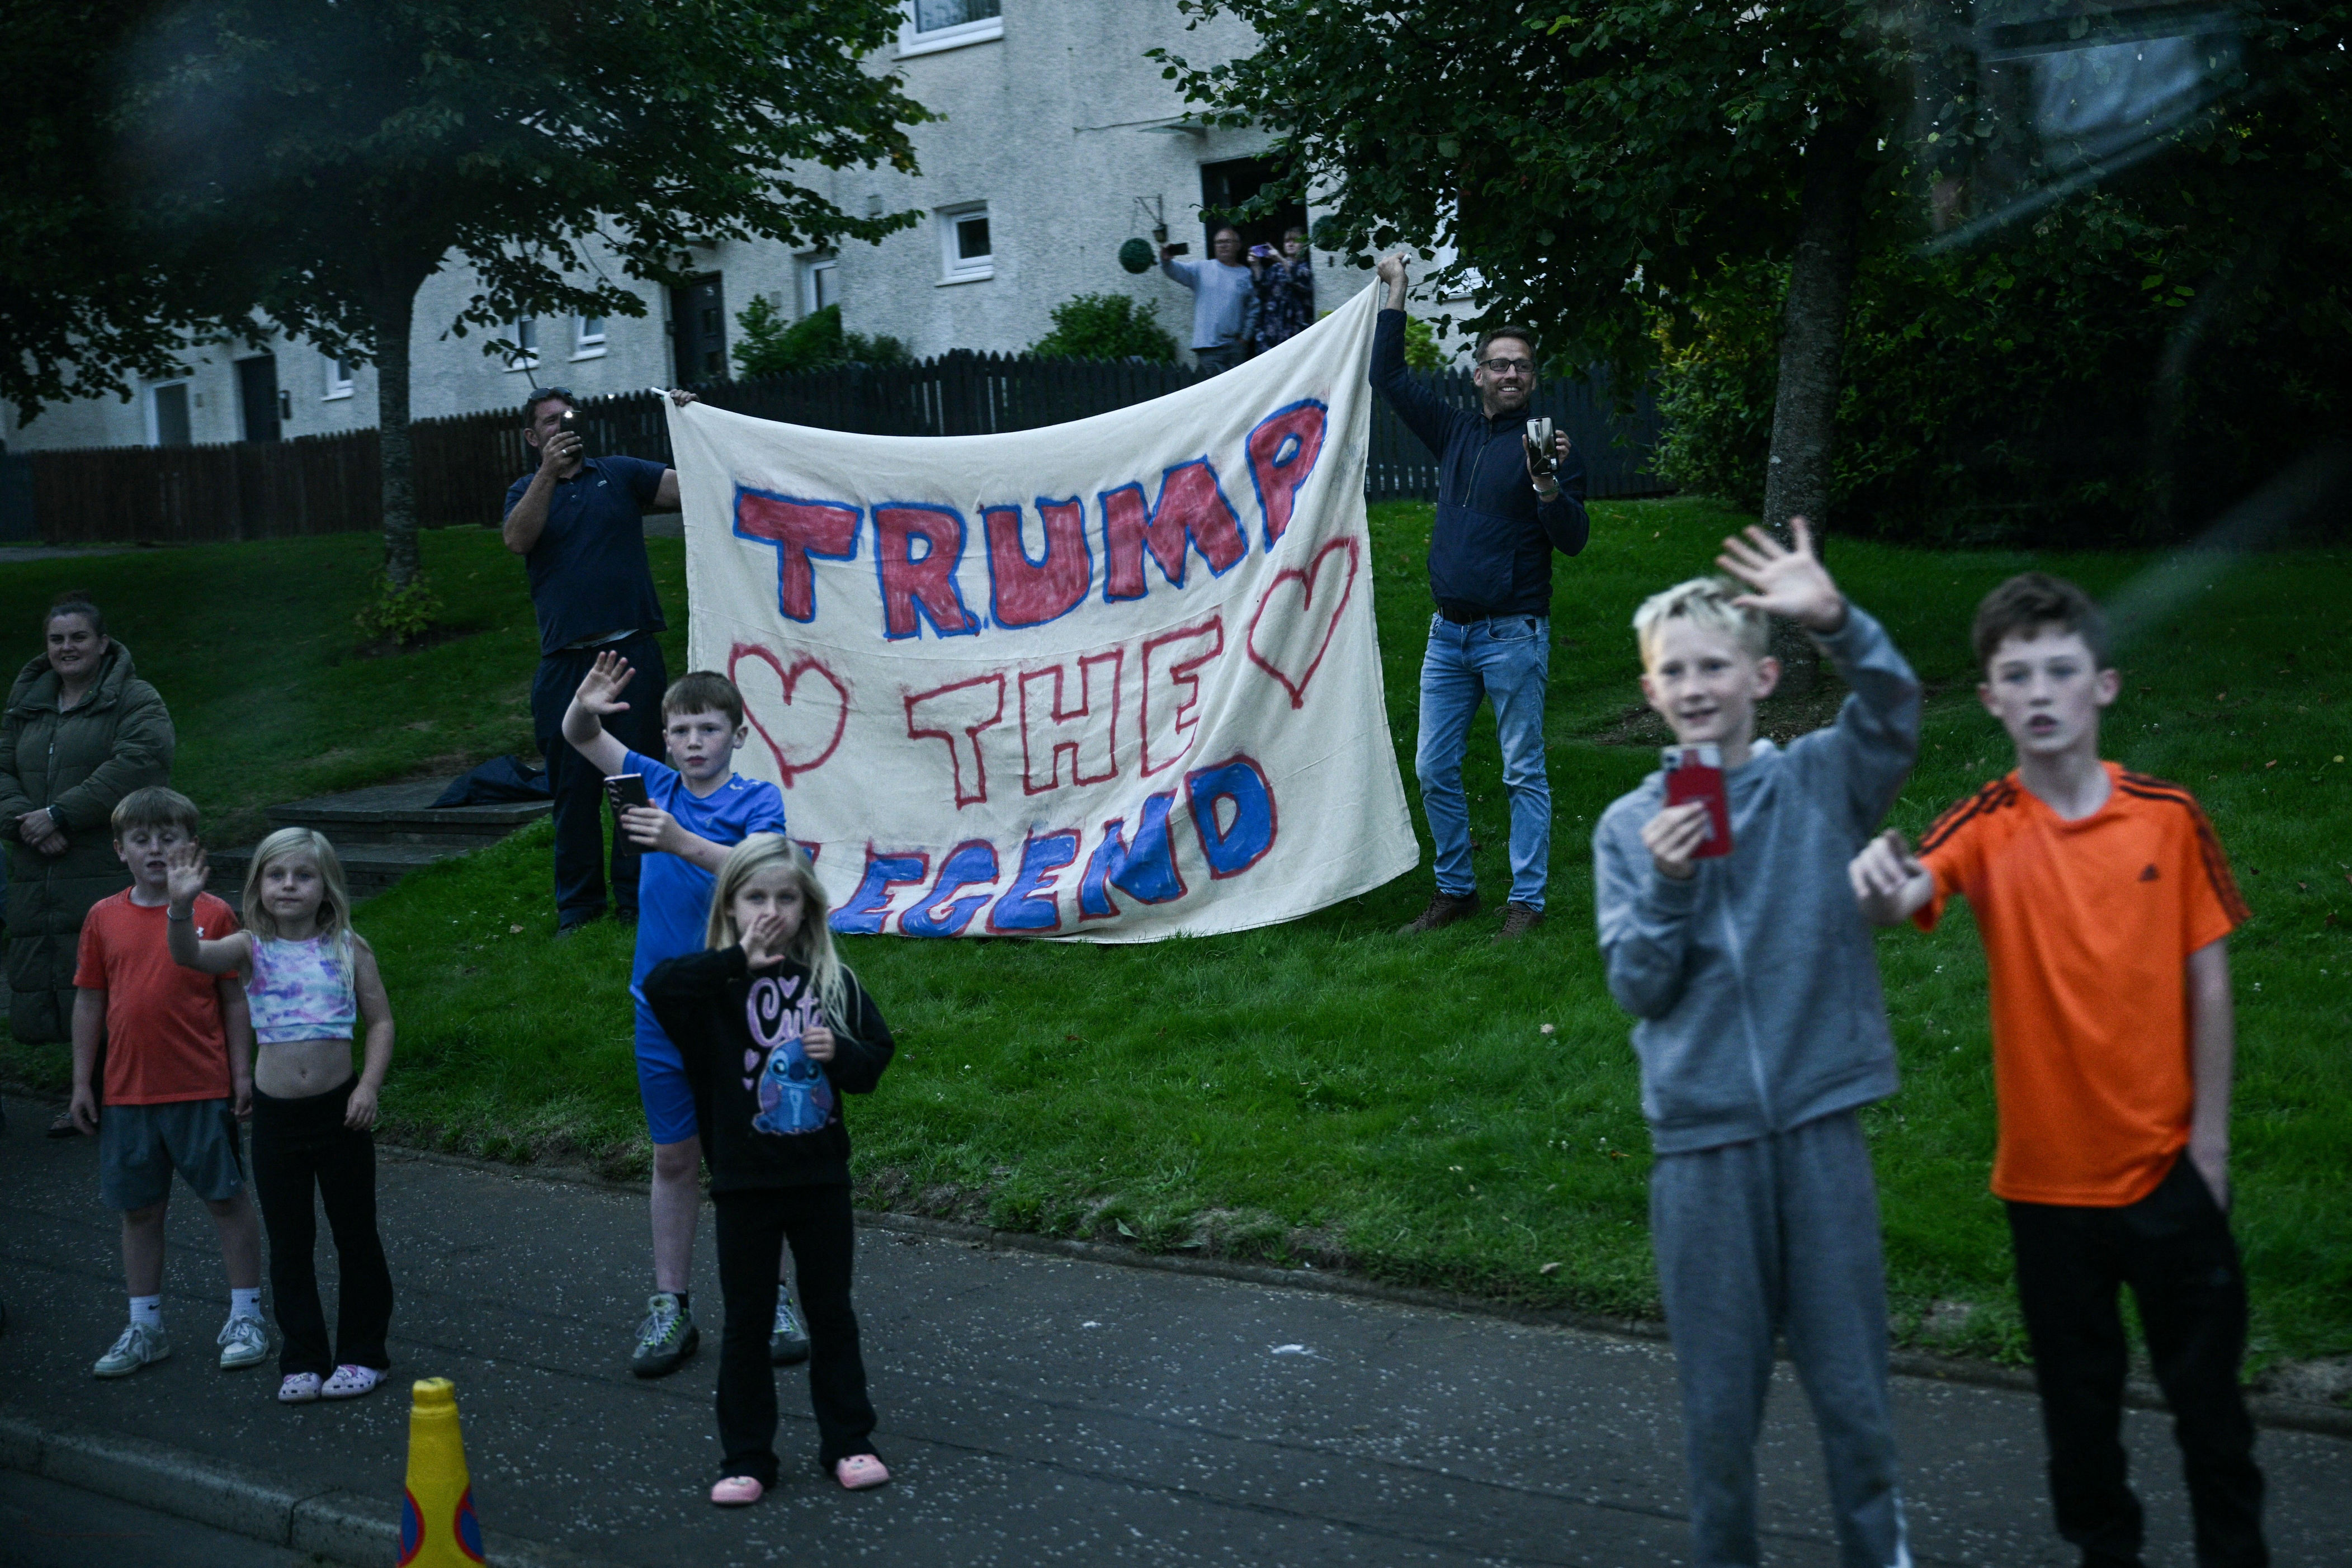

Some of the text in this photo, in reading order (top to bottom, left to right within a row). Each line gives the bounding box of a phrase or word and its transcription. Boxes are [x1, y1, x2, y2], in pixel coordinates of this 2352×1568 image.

[733, 398, 1329, 641] TRUMP
[904, 615, 1224, 810] THE
[795, 755, 1277, 938] EGEND
